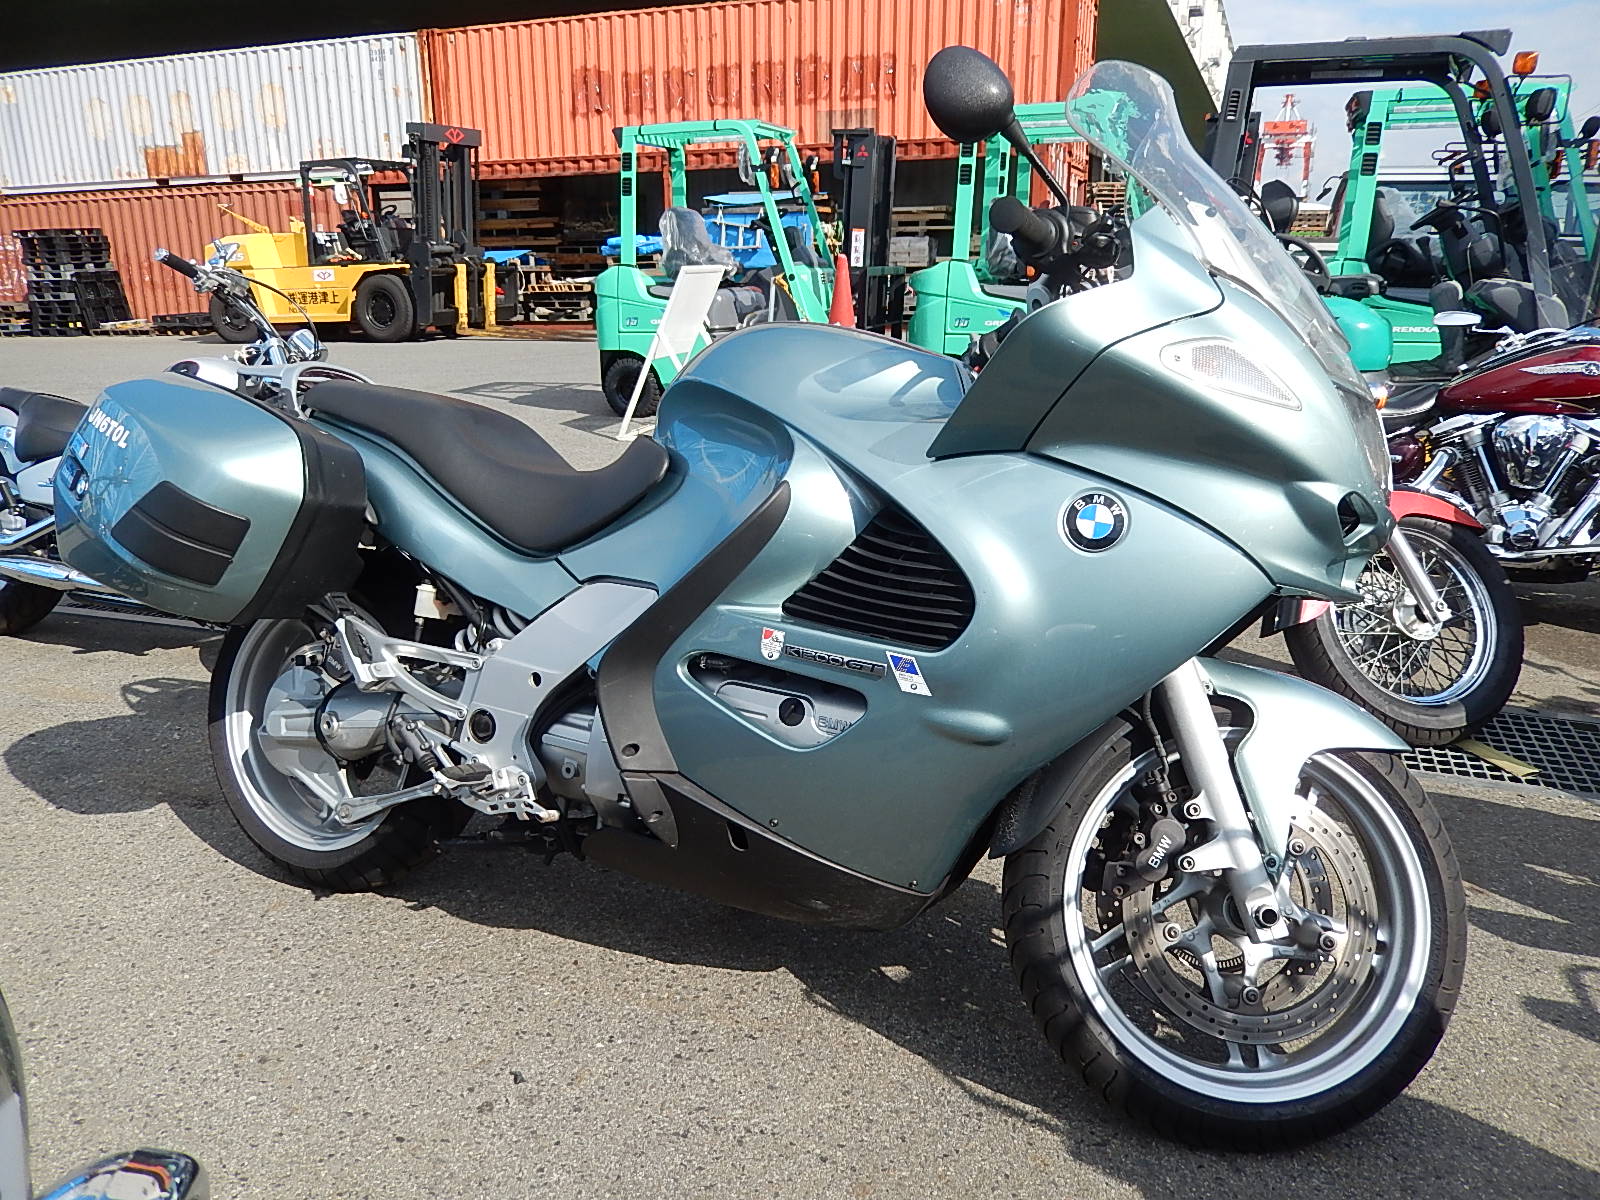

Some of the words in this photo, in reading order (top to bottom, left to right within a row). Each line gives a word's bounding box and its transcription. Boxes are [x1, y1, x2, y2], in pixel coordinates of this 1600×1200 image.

[1073, 494, 1123, 516] BMW
[327, 655, 342, 671] BMW
[1148, 834, 1172, 869] BMW
